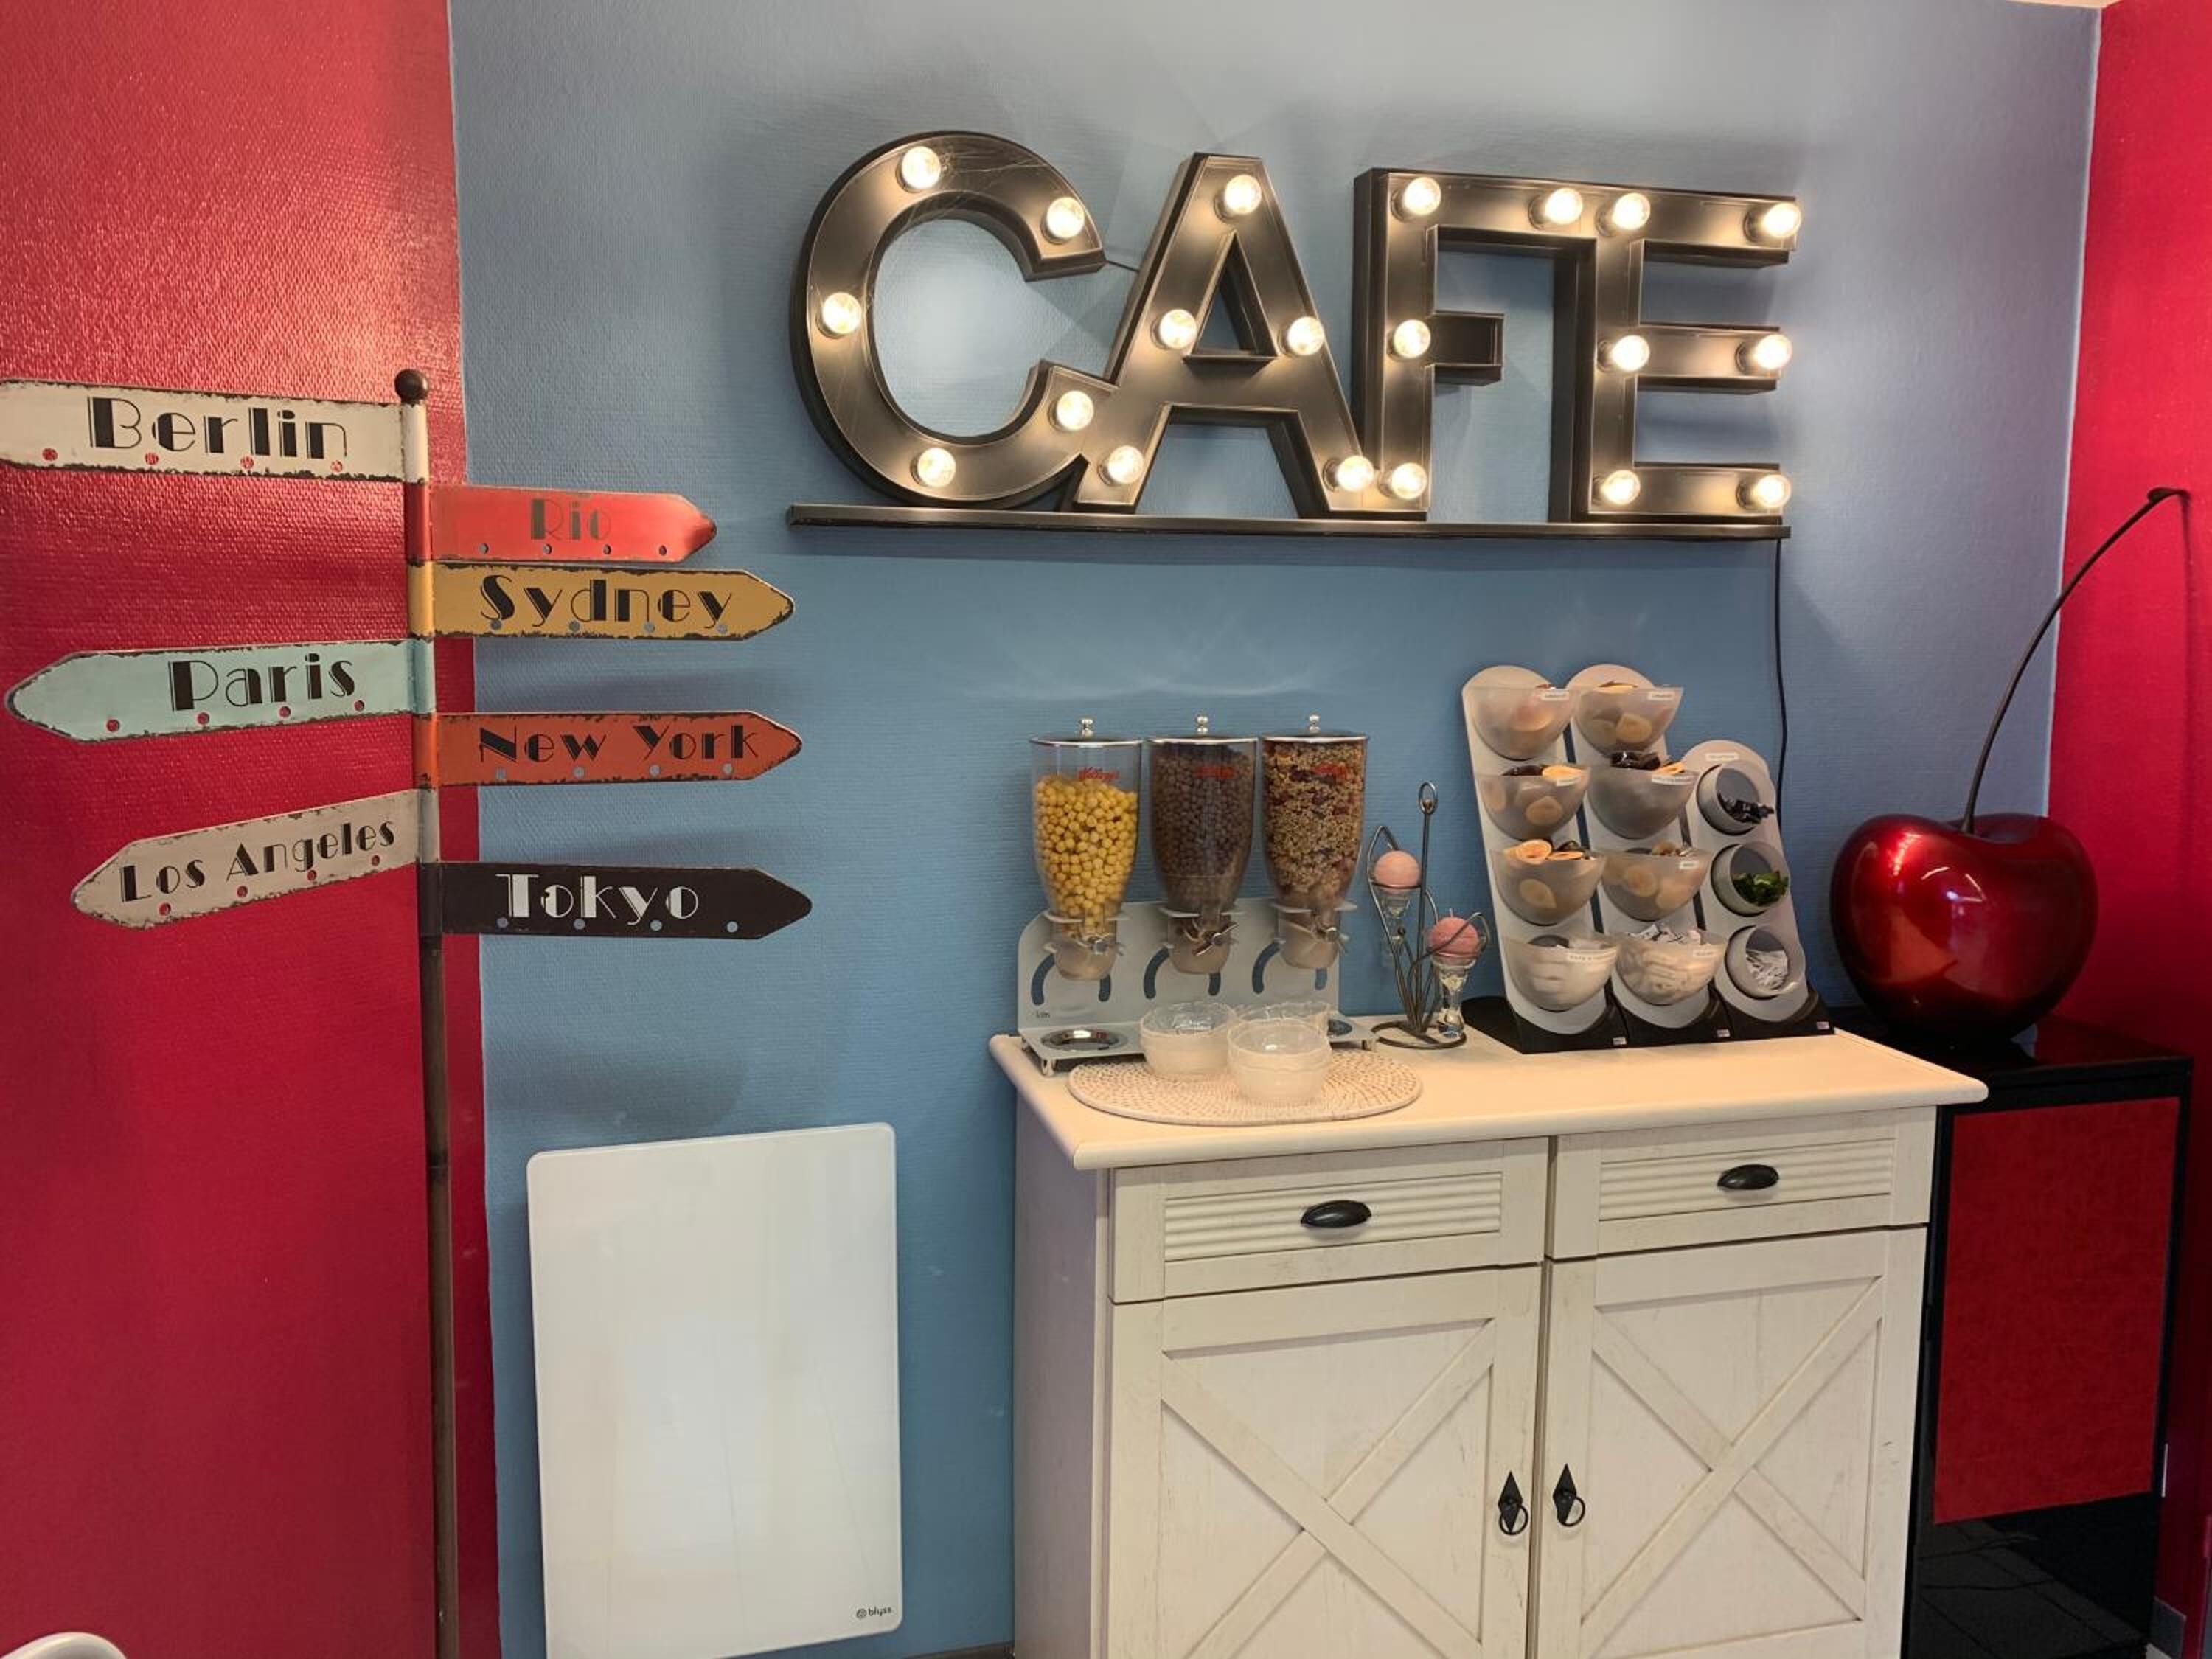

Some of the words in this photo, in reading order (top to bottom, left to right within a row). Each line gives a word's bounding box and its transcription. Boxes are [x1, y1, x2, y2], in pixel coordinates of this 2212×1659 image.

[790, 130, 1801, 525] CAFE
[86, 396, 347, 459] Berlin
[530, 498, 611, 540] Rio
[480, 574, 732, 629] Sydney
[167, 653, 355, 712] Paris
[479, 726, 606, 762] New
[632, 725, 757, 762] York
[119, 859, 206, 902] Los
[226, 821, 394, 883] Angeles
[495, 874, 699, 926] Tokyo
